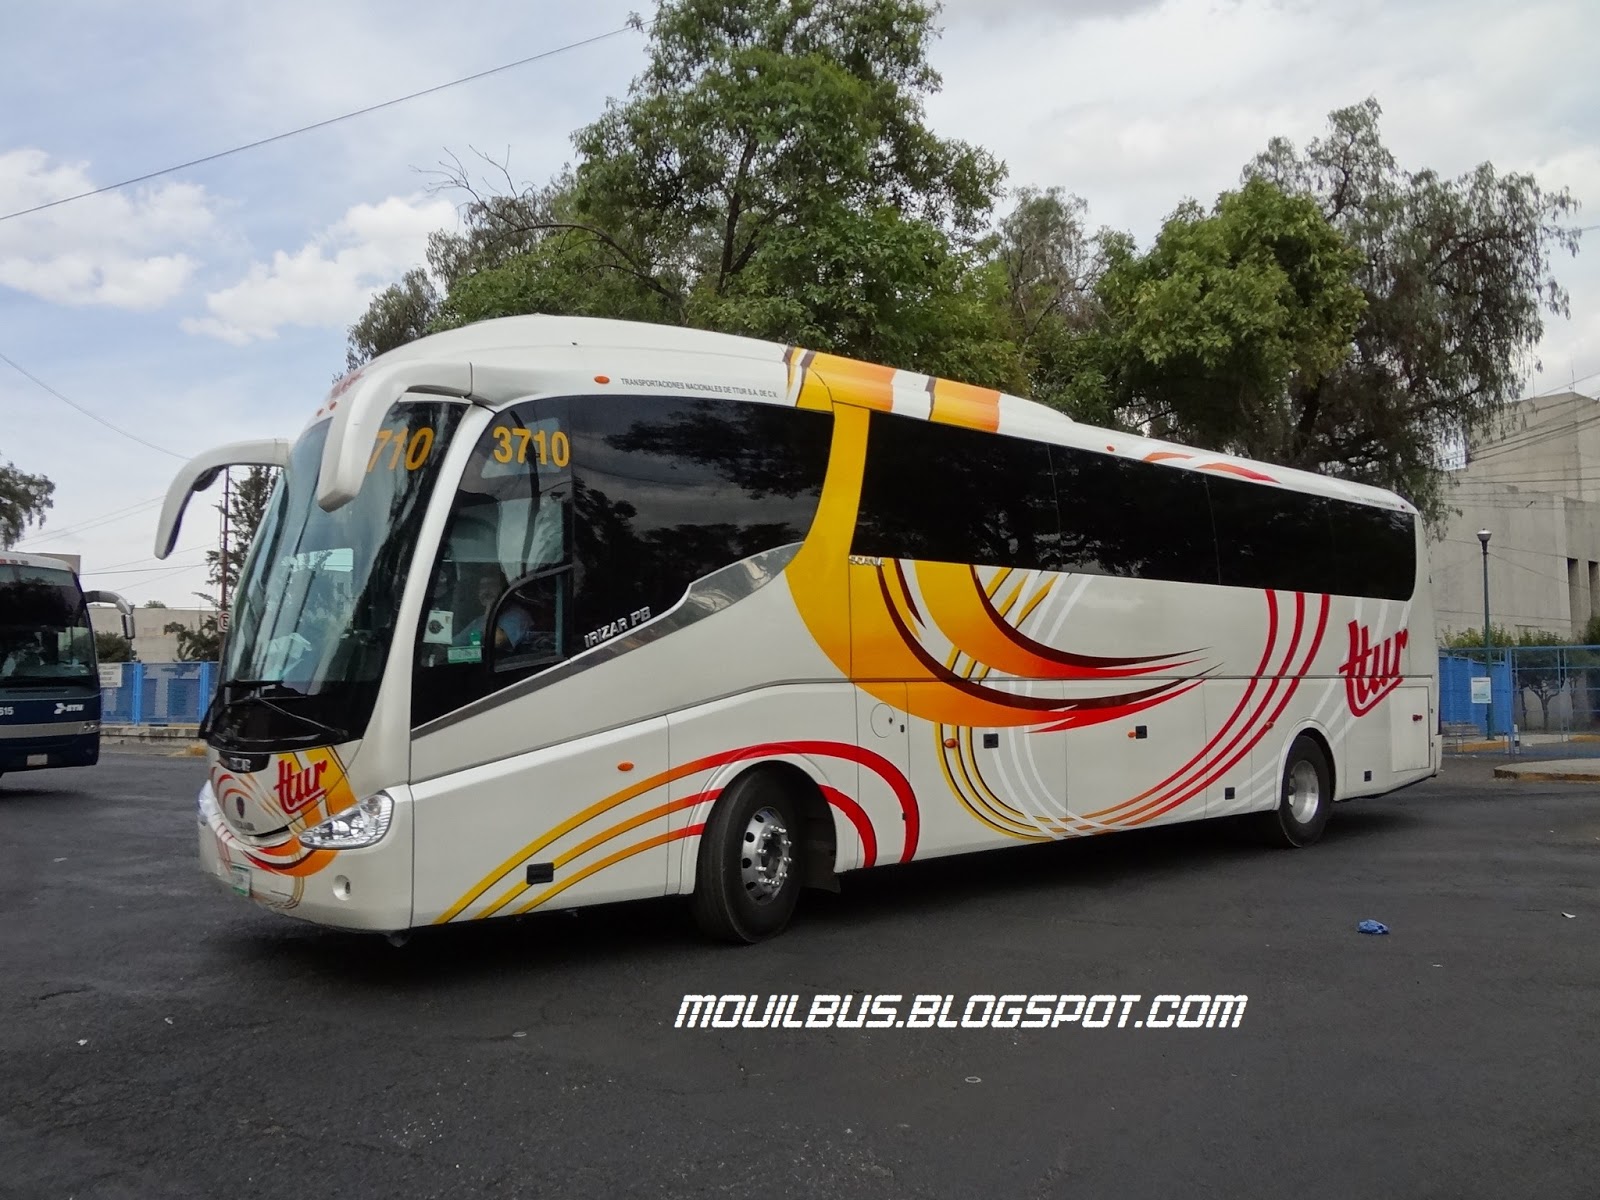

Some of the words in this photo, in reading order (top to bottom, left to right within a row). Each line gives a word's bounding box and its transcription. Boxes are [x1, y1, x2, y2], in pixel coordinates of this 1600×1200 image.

[620, 377, 685, 390] TRANSPORTACIONES
[685, 382, 723, 393] NACIONALES
[723, 386, 732, 394] DE
[759, 389, 767, 397] DE
[493, 426, 570, 468] 3710
[584, 617, 629, 648] IRIZAR
[630, 606, 651, 626] PB
